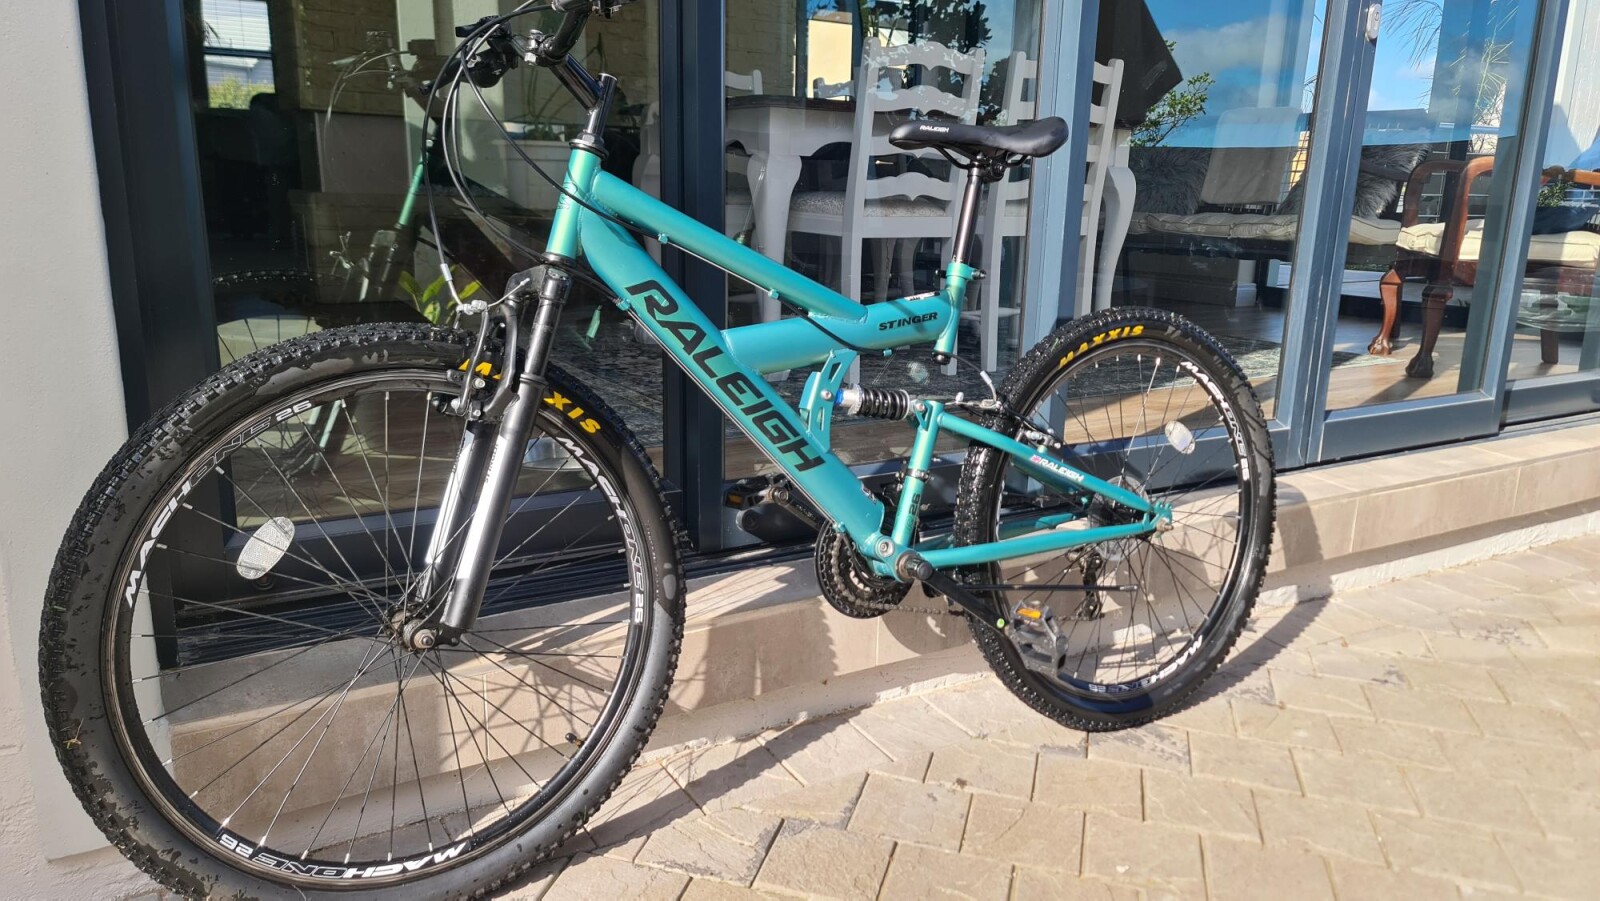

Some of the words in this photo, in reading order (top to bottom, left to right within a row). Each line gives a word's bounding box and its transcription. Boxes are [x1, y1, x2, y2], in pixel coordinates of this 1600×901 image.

[919, 124, 950, 133] RALEIGH
[878, 311, 938, 331] STINGER
[1059, 325, 1145, 368] MAXXIS
[624, 279, 826, 472] RALEIGH
[275, 400, 313, 422] 26
[1040, 458, 1085, 482] RALEIGH
[909, 492, 921, 515] 26
[634, 593, 645, 624] 26
[219, 833, 254, 858] 26
